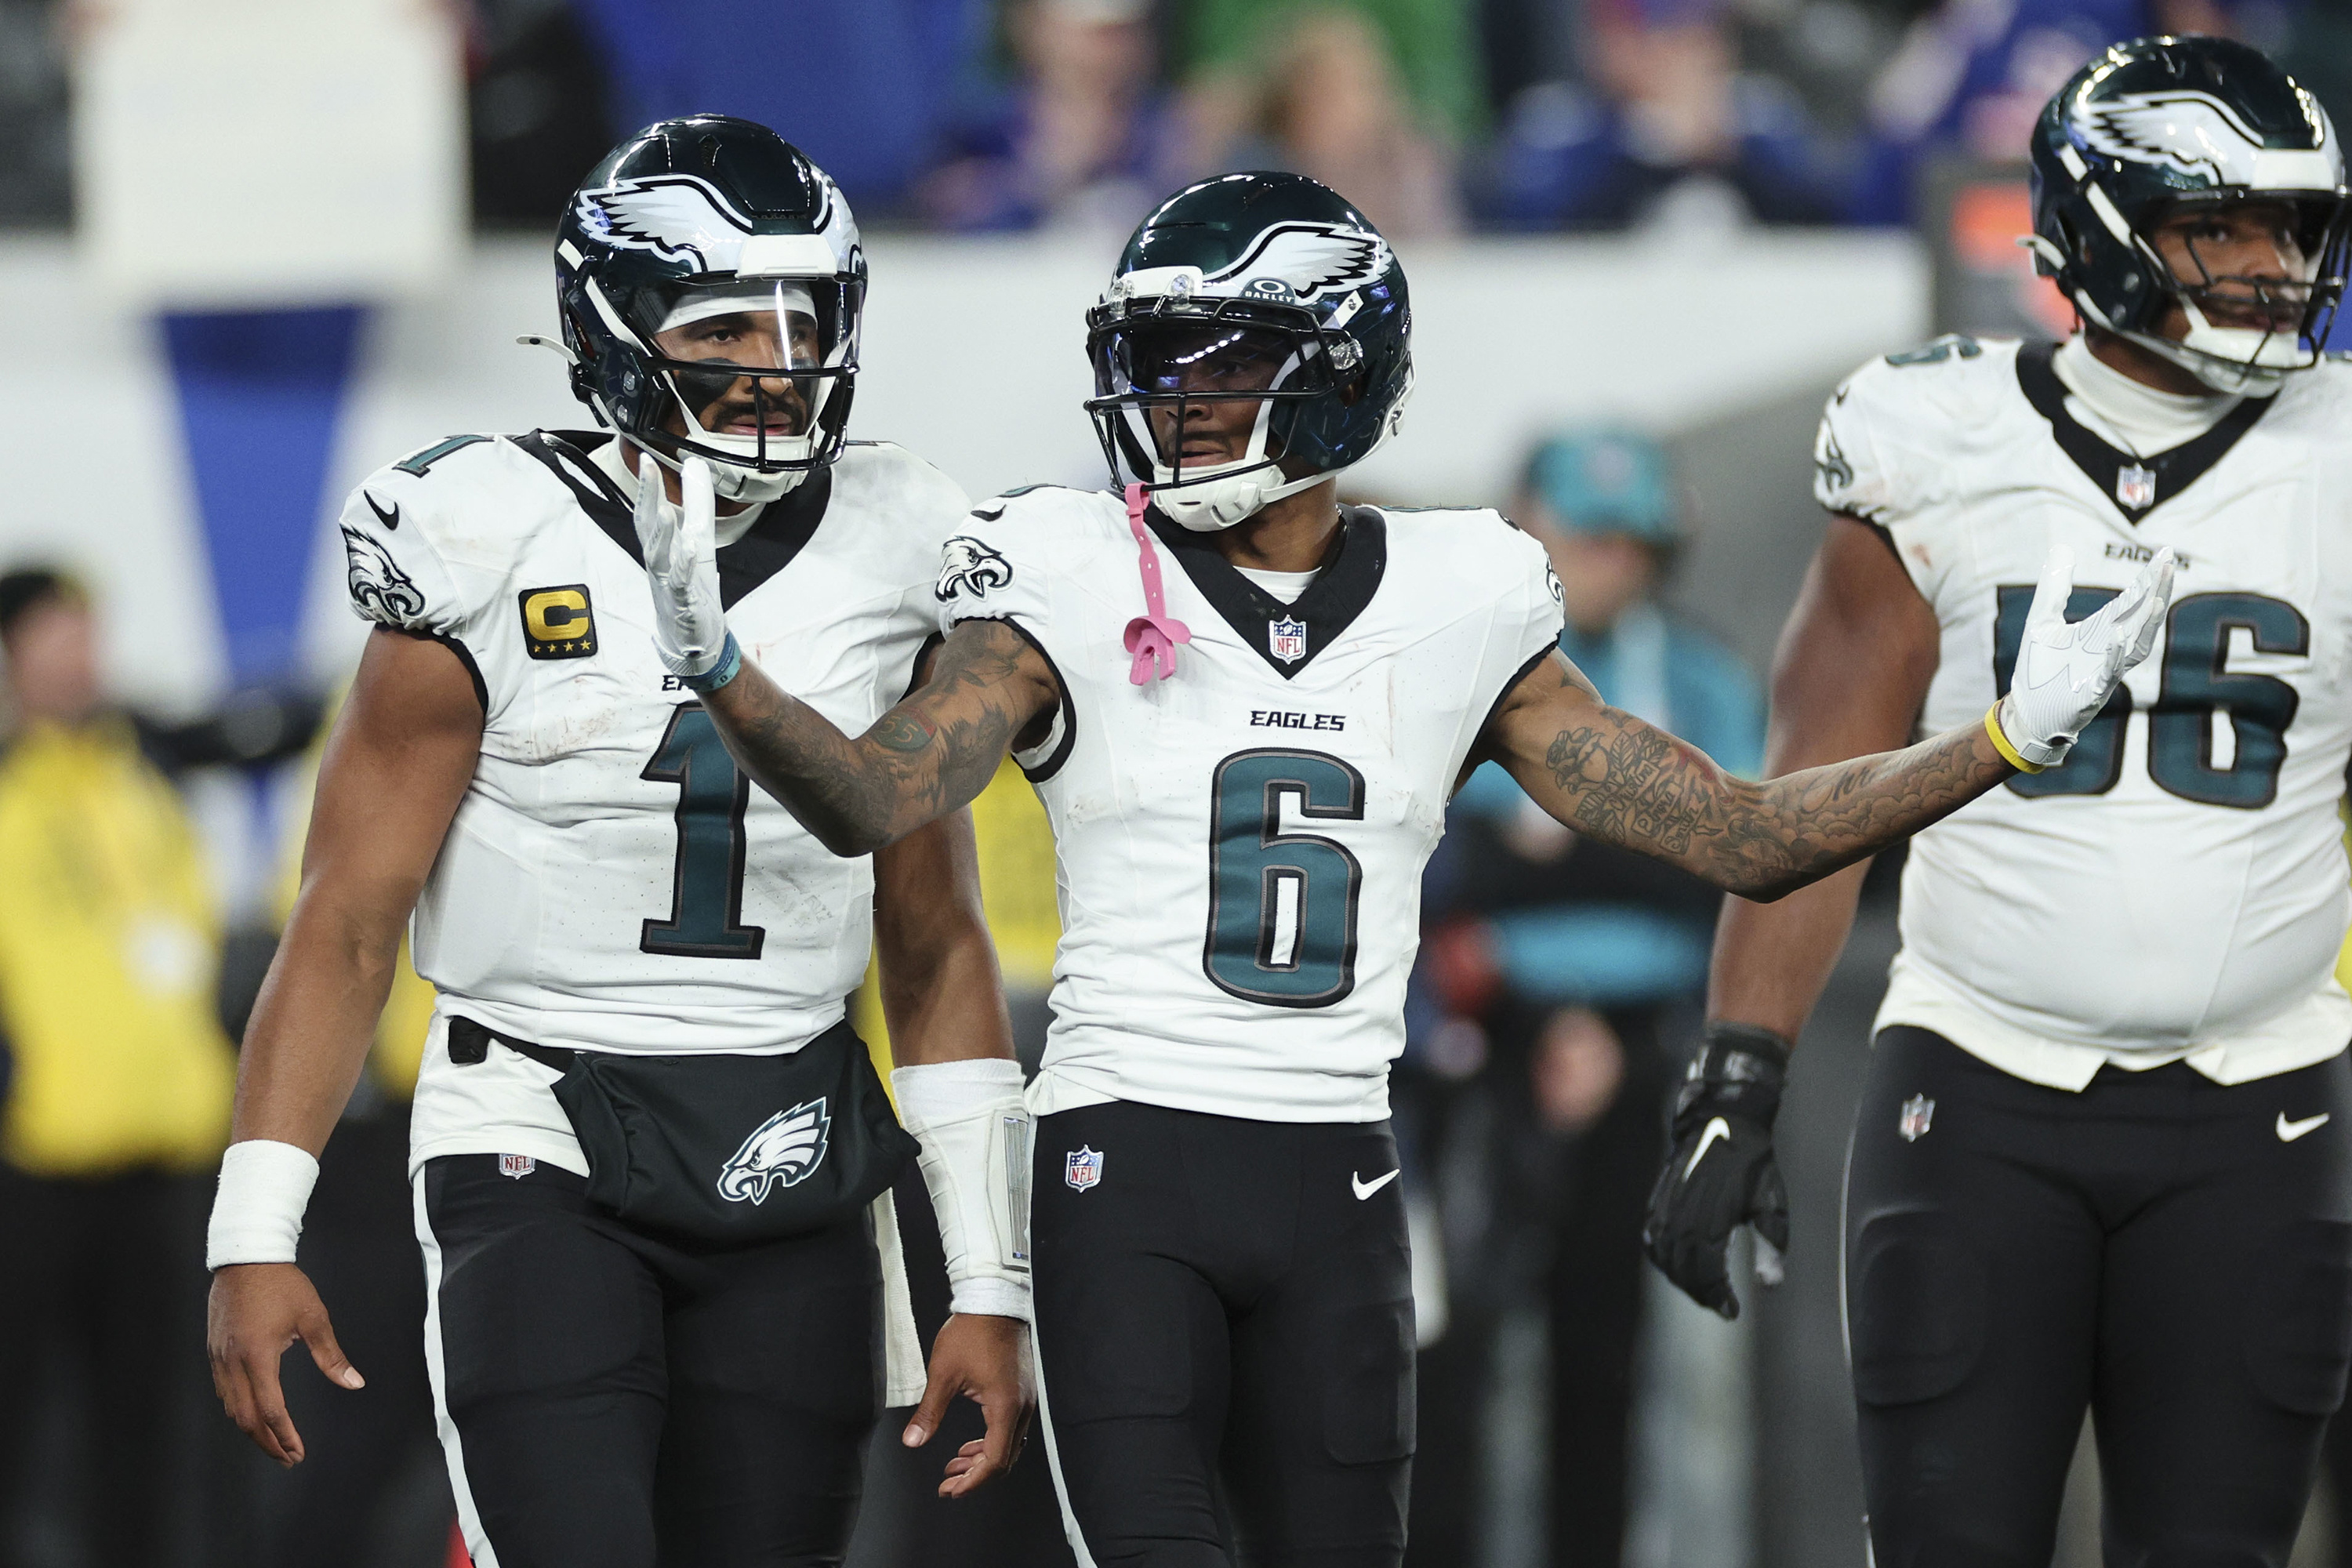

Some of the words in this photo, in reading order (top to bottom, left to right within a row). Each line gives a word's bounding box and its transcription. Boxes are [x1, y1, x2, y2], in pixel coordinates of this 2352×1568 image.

[1245, 291, 1294, 303] OAKLEY
[525, 590, 590, 641] C
[1277, 637, 1301, 655] NFL
[1250, 710, 1347, 731] EAGLES
[639, 699, 766, 960] 1
[1202, 746, 1367, 1009] 6
[504, 1156, 531, 1171] NFL
[1071, 1167, 1094, 1183] NFL
